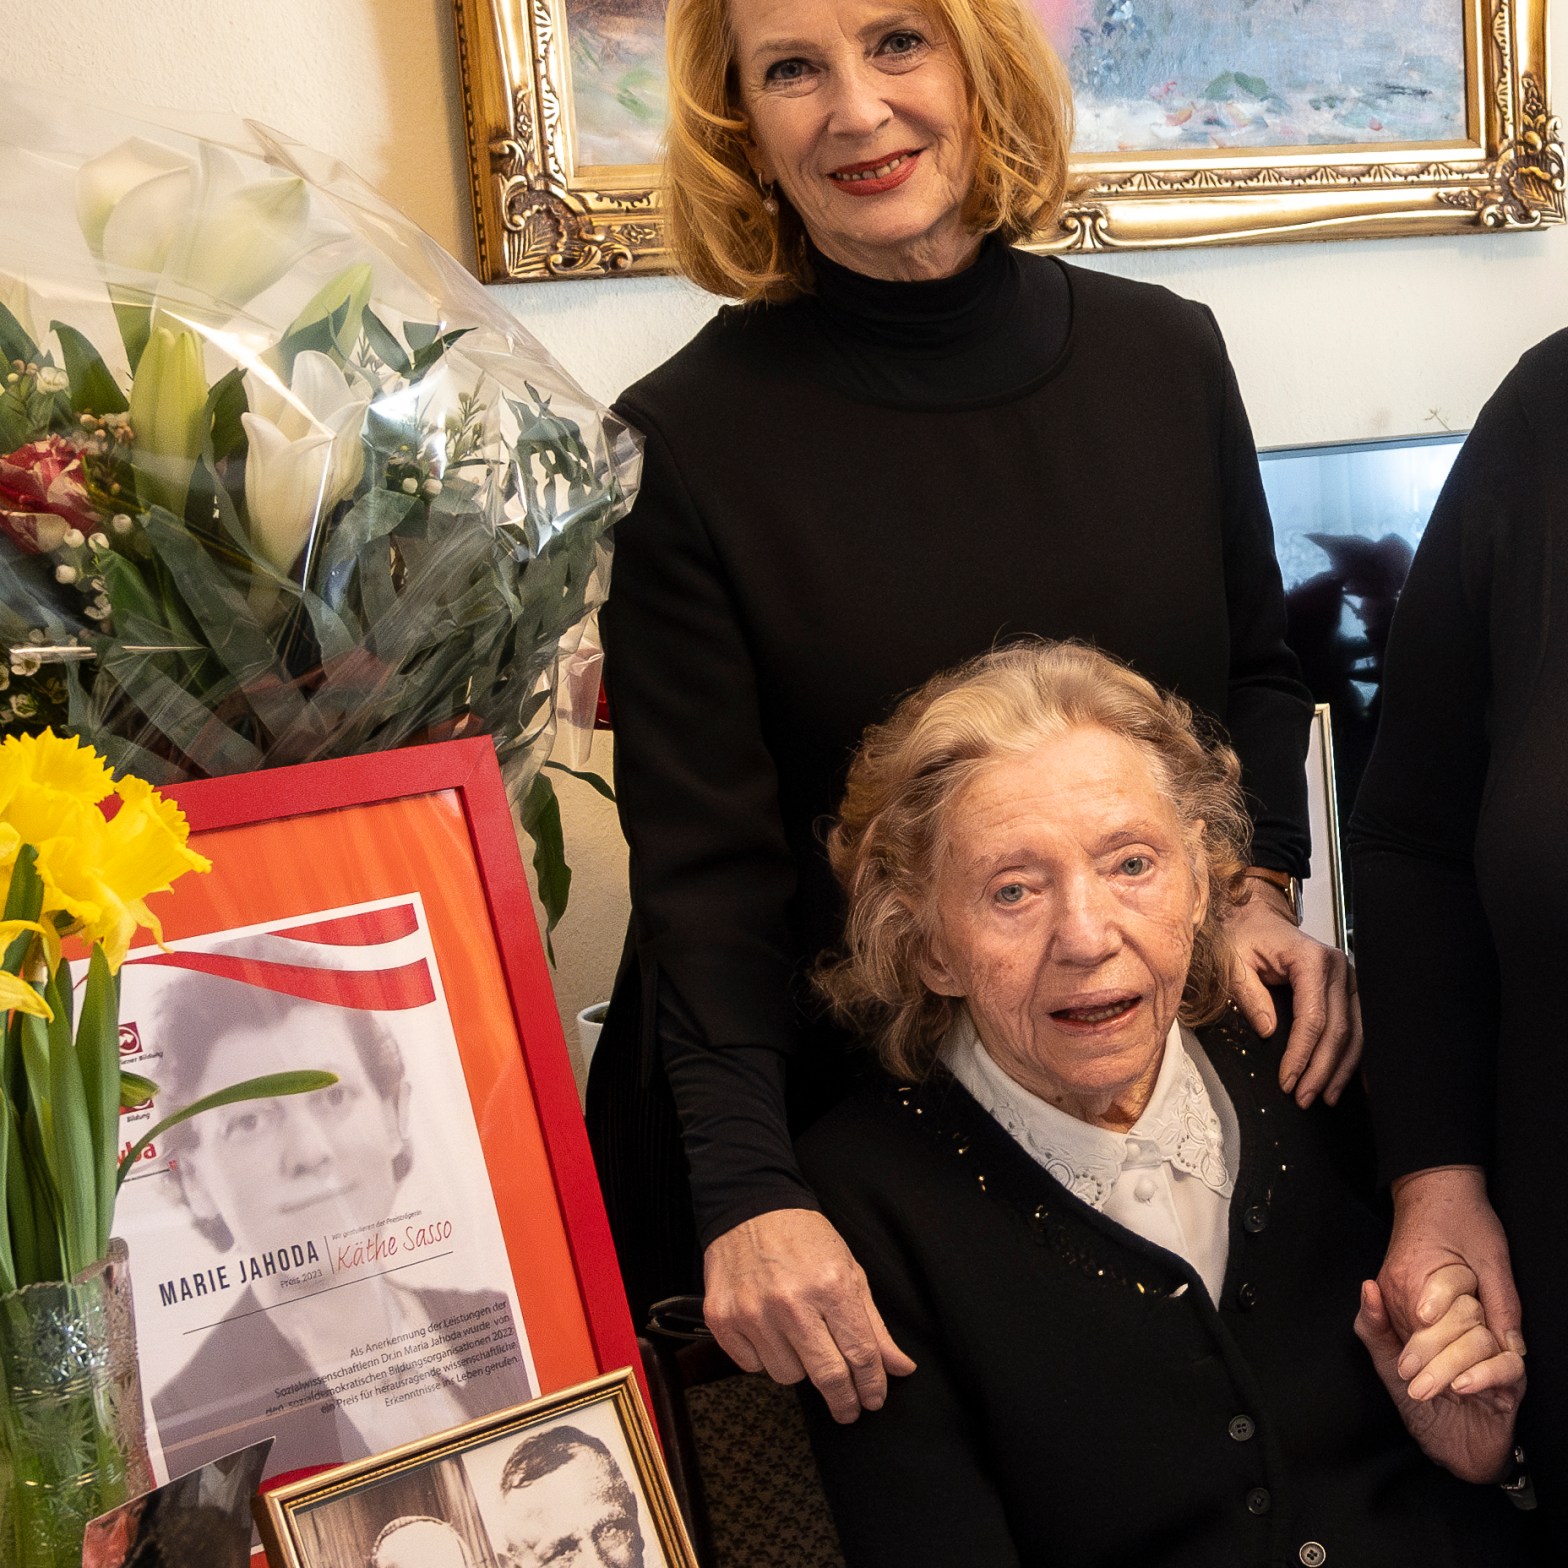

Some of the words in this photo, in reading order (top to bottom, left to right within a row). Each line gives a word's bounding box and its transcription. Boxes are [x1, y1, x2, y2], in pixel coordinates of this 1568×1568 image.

[127, 1113, 151, 1123] Bildung
[158, 1265, 231, 1307] MARIE
[239, 1240, 320, 1284] JAHODA
[337, 1232, 398, 1271] Käthe
[403, 1220, 452, 1251] Sasso
[280, 1276, 301, 1289] Preis
[302, 1269, 323, 1283] 2023
[274, 1358, 380, 1398] Sozialwissenschaftlerin
[404, 1341, 429, 1355] Maria
[431, 1331, 462, 1348] Jahoda
[463, 1321, 490, 1336] wurde
[493, 1314, 510, 1326] von
[350, 1347, 364, 1358] Als
[366, 1327, 426, 1353] Anerkennung
[428, 1321, 442, 1332] der
[443, 1306, 491, 1328] Leistungen
[492, 1300, 507, 1312] der
[288, 1370, 387, 1408] sozialdemokratischen
[388, 1335, 491, 1374] Bildungsorganisationen
[492, 1327, 514, 1342] 2022
[320, 1403, 336, 1414] ein
[336, 1394, 359, 1408] Preis
[360, 1389, 373, 1401] für
[375, 1366, 441, 1396] herausragende
[442, 1341, 516, 1372] wissenschaftliche
[384, 1380, 441, 1407] Erkenntnisse
[442, 1376, 455, 1388] ins
[456, 1367, 484, 1383] Leben
